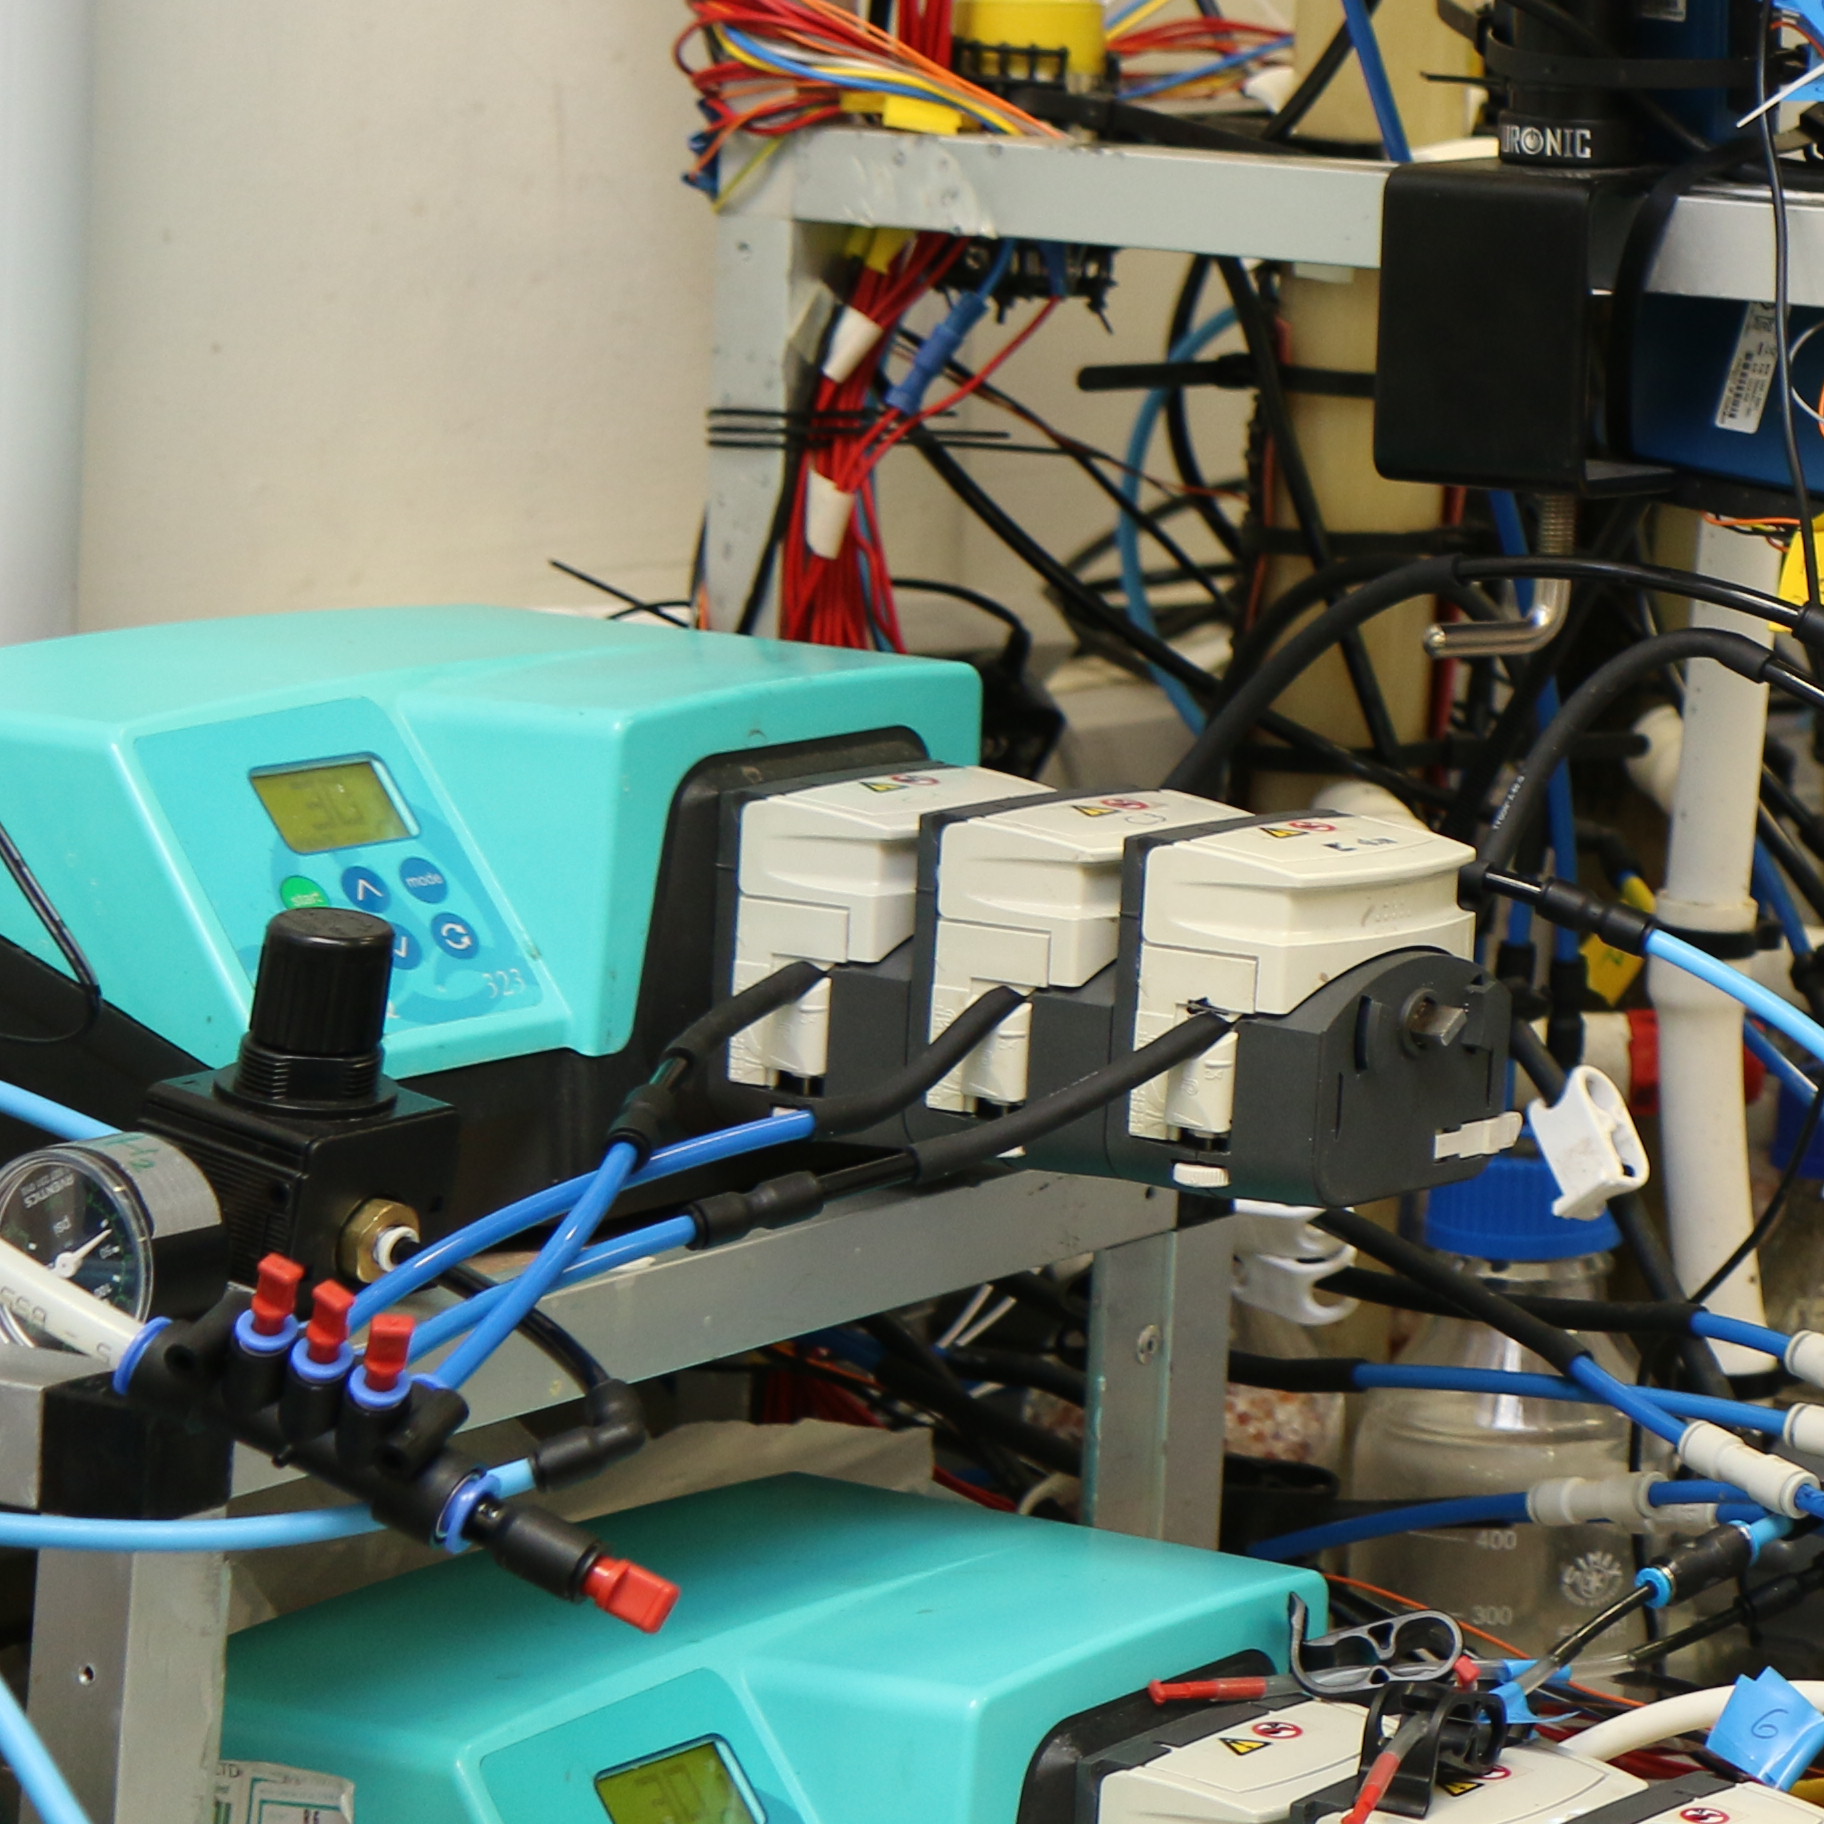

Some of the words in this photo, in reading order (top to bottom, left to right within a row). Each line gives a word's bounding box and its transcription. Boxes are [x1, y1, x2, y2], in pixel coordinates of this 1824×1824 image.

[405, 872, 443, 889] mode
[290, 891, 323, 907] start
[481, 968, 526, 998] 323
[1475, 1530, 1517, 1551] 400
[1471, 1604, 1513, 1626] 300
[1750, 1708, 1788, 1739] 6
